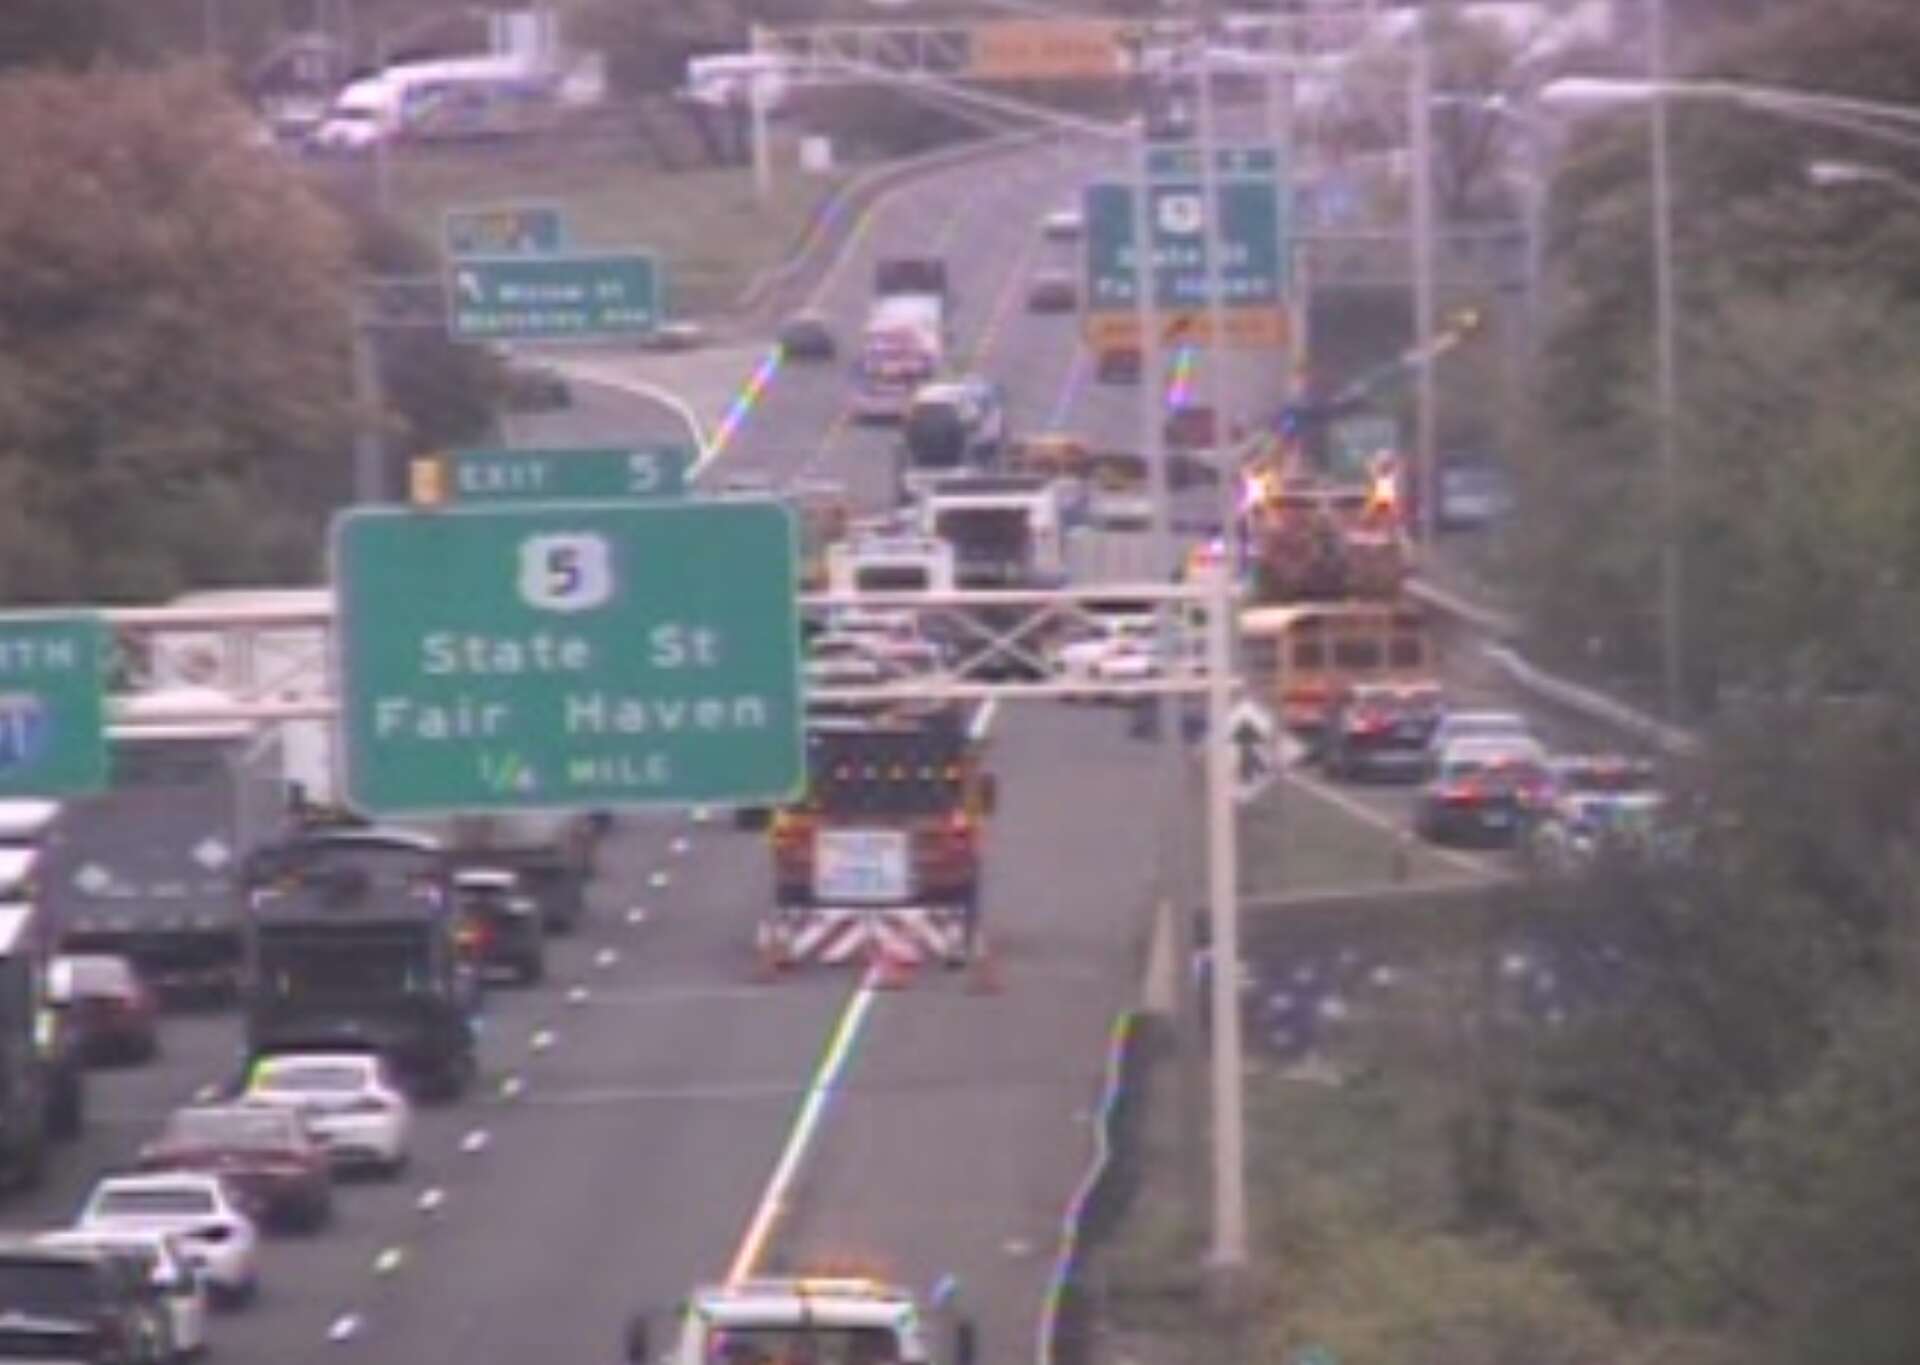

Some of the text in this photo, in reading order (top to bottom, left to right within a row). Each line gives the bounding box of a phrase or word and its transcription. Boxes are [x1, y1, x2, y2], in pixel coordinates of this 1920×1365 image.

[458, 453, 661, 491] EXIT 5
[547, 548, 582, 598] 5
[421, 625, 719, 675] State St
[375, 692, 767, 740] Fair Haven
[570, 755, 671, 785] MILE
